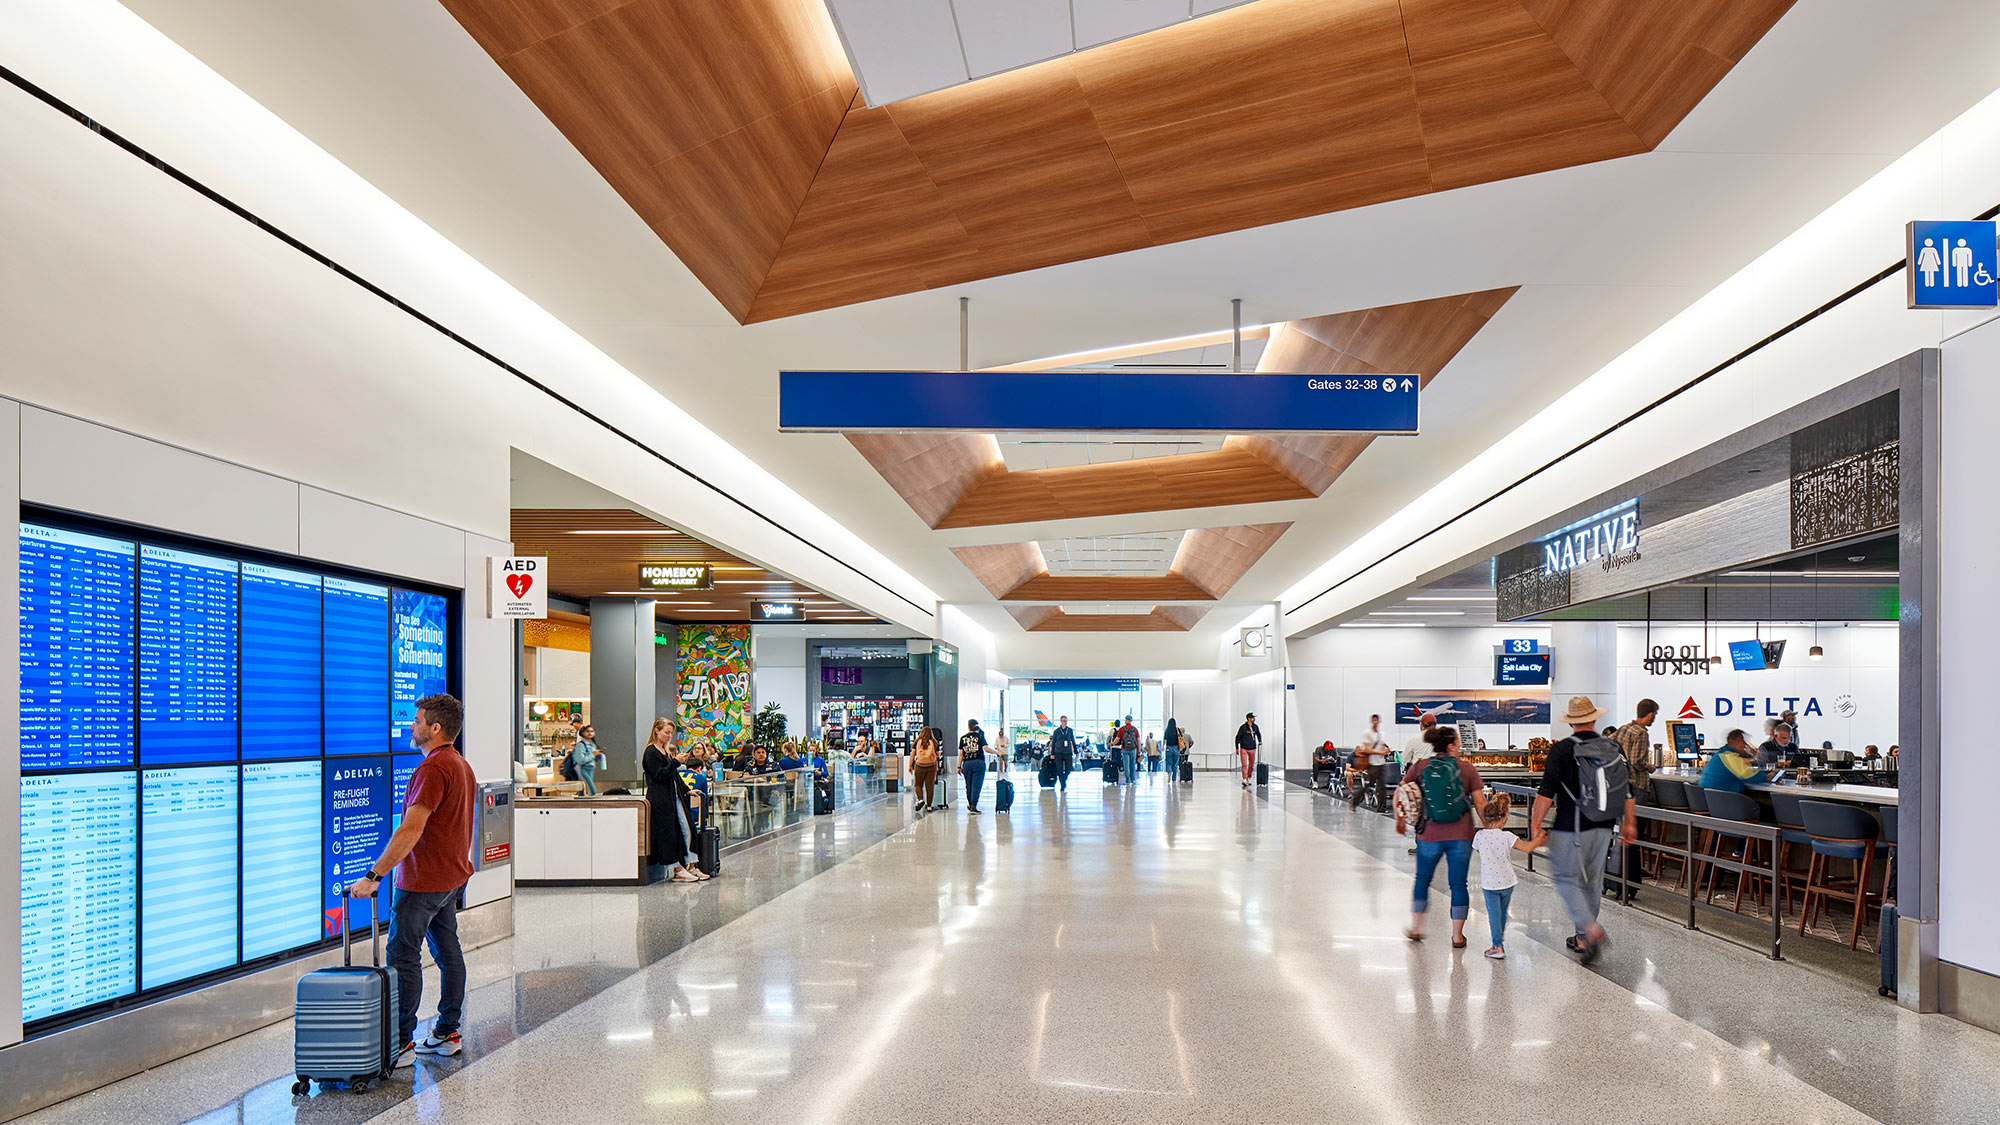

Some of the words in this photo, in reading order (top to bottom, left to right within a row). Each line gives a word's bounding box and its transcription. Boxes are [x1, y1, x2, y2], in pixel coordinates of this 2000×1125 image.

[1308, 379, 1342, 390] Gates
[1345, 379, 1378, 390] 32-38
[24, 527, 50, 537] DELTA
[1545, 511, 1637, 575] NATIVE
[142, 559, 167, 568] Departures
[503, 560, 536, 570] AED
[1602, 560, 1610, 573] by
[642, 568, 704, 577] HOMEBOY
[400, 614, 410, 624] You
[411, 616, 420, 626] See
[399, 623, 443, 645] Something
[404, 640, 414, 650] Say
[1513, 640, 1531, 652] 33
[399, 647, 443, 667] Something
[682, 671, 750, 706] JAMBA
[1715, 697, 1823, 717] DELTA
[344, 768, 374, 779] DELTA
[334, 788, 370, 799] PRE-FLIGHT
[334, 798, 370, 810] REMINDERS
